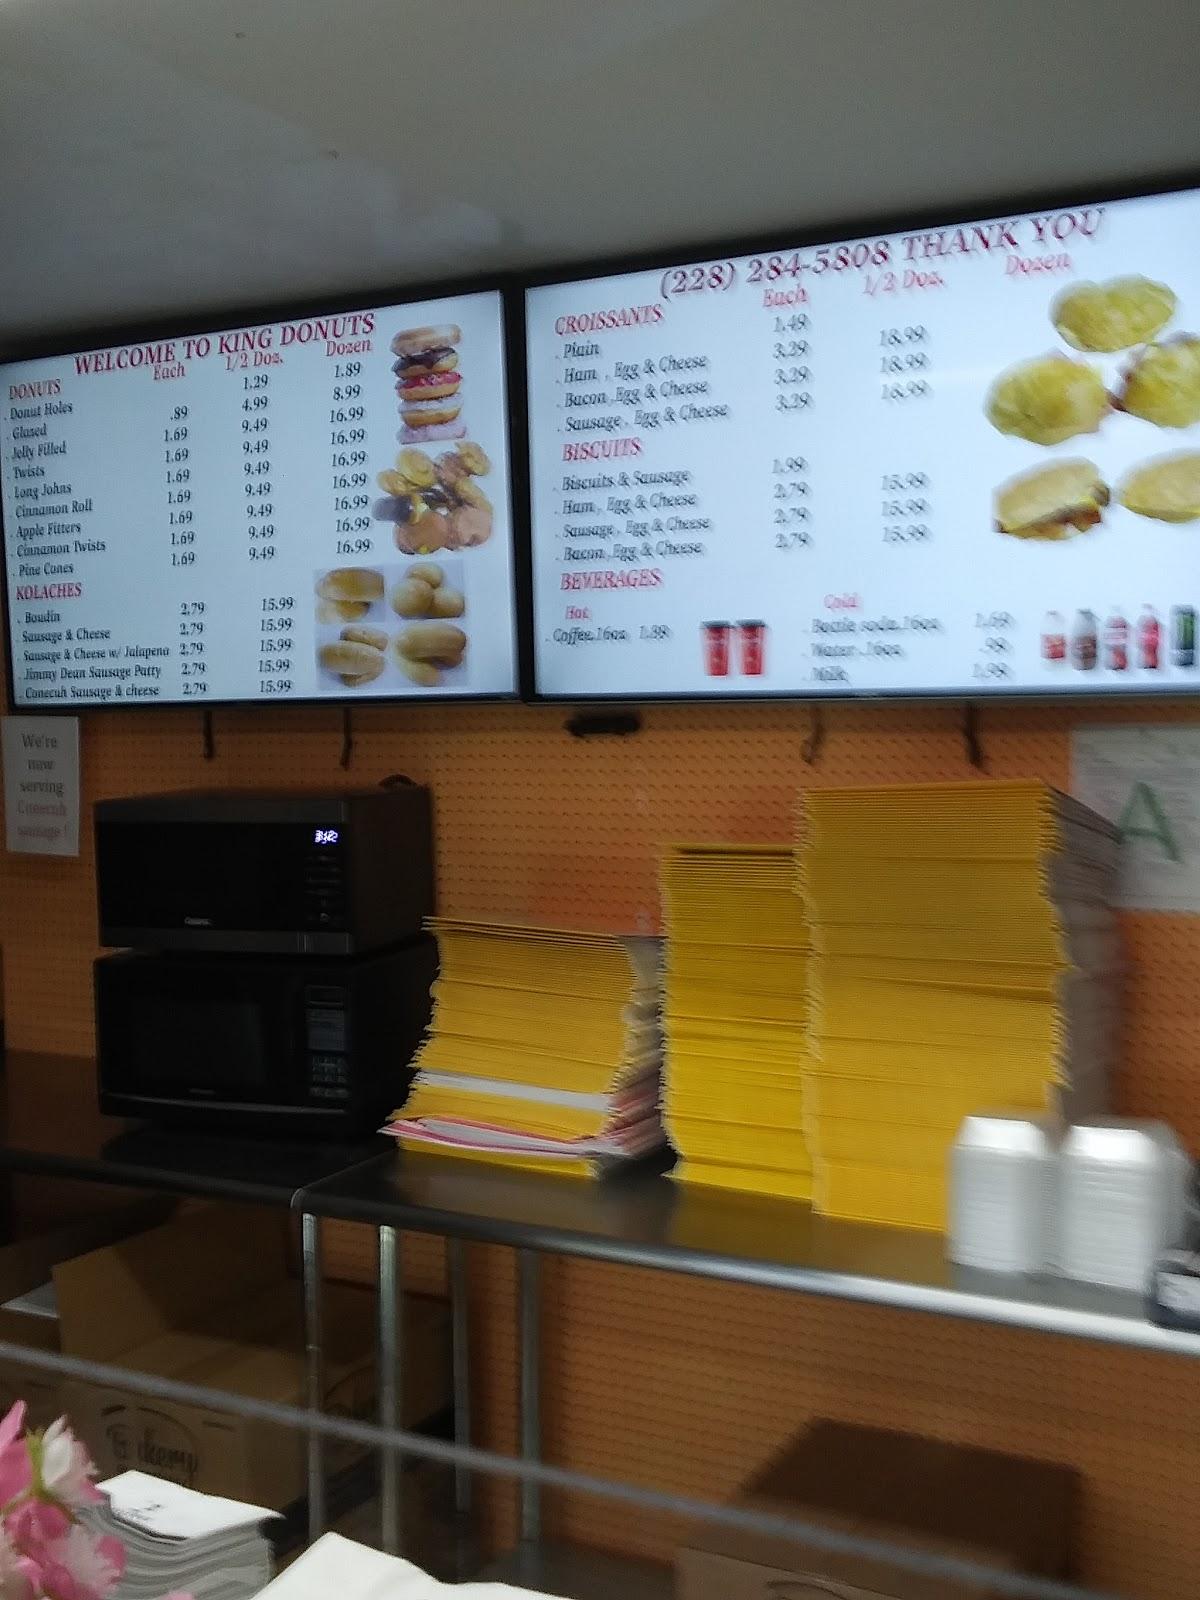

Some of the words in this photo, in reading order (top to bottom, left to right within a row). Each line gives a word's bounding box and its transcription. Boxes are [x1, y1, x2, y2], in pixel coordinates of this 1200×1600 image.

[659, 262, 736, 302] (228)
[745, 239, 891, 285] 284-5808
[902, 221, 1020, 262] THANK
[1028, 206, 1106, 244] YOU
[762, 284, 809, 309] Each
[863, 272, 896, 297] 1/2
[1005, 251, 1072, 276] Dozen
[554, 303, 664, 336] CROISSANTS
[74, 342, 175, 375] WELCOME
[182, 337, 210, 360] TO
[218, 328, 272, 354] KING
[280, 313, 374, 346] DONUTS
[563, 340, 601, 359] Plain
[773, 313, 809, 333] 1.49
[153, 362, 186, 381] Each
[225, 354, 248, 372] 1/2
[253, 351, 283, 367] Doz.
[326, 339, 371, 357] Dozen
[613, 361, 640, 381] Egg
[643, 359, 655, 375] &
[658, 354, 708, 373] Cheese
[9, 379, 61, 400] DONUTS
[10, 403, 41, 420] Donut
[44, 400, 73, 416] Holes
[243, 374, 269, 390] 1.29
[334, 362, 361, 378] 1.89
[644, 384, 656, 399] &
[660, 379, 709, 398] Cheese
[12, 424, 47, 440] Glazed
[170, 406, 188, 421] .89
[241, 396, 268, 411] 4.99
[333, 384, 361, 401] 8.99
[634, 408, 660, 429] Egg
[663, 406, 676, 422] &
[679, 403, 729, 421] Cheese
[12, 445, 34, 461] Jelly
[38, 441, 67, 456] Filled
[164, 427, 188, 442] 1.69
[241, 417, 268, 433] 9.49
[329, 406, 365, 423] 16.99
[13, 465, 45, 479] Twists
[165, 448, 189, 463] 1.69
[242, 439, 269, 455] 9.49
[330, 429, 365, 445] 16.99
[562, 437, 642, 462] BISCUITS
[14, 486, 38, 499] Long
[41, 482, 72, 496] Johns
[166, 469, 190, 484] 1.69
[243, 460, 270, 476] 9.49
[331, 450, 366, 467] 16.99
[561, 472, 615, 492] Biscuits
[618, 472, 630, 487] &
[633, 469, 692, 488] Sausage
[15, 502, 69, 518] Cinnamon
[72, 499, 93, 513] Roll
[167, 490, 191, 504] 1.69
[244, 482, 271, 497] 9.49
[332, 473, 367, 489] 16.99
[607, 496, 632, 514] Egg
[635, 494, 647, 510] &
[650, 492, 697, 508] Cheese
[773, 481, 810, 499] 2.79
[16, 525, 44, 541] Apple
[168, 511, 193, 525] 1.69
[246, 503, 273, 519] 9.49
[334, 495, 369, 511] 16.99
[626, 519, 650, 538] Egg
[652, 517, 664, 532] &
[666, 516, 711, 531] Cheese
[773, 507, 810, 524] 2.79
[16, 543, 70, 557] Cinnamon
[73, 540, 106, 553] Twists
[170, 531, 195, 545] 1.69
[248, 524, 275, 540] 9.49
[335, 517, 370, 532] 16.99
[641, 541, 653, 556] &
[656, 539, 705, 556] Cheese
[775, 532, 811, 549] 2.79
[19, 564, 40, 577] Pine
[44, 562, 74, 575] Cones
[171, 552, 195, 566] 1.69
[248, 546, 275, 561] 9.49
[336, 539, 371, 554] 16.99
[16, 582, 82, 600] KOLACHES
[560, 568, 664, 590] BEVERAGES
[25, 610, 61, 624] Boudin
[181, 602, 205, 615] 2.79
[261, 597, 294, 611] 15.99
[565, 605, 590, 620] Hot
[22, 630, 62, 644] Sausage
[65, 630, 73, 640] &
[76, 628, 111, 640] Cheese
[179, 622, 204, 636] 2.79
[260, 618, 292, 632] 15.99
[23, 650, 61, 664] Sausage
[63, 650, 71, 660] &
[73, 648, 106, 660] Cheese
[179, 643, 203, 655] 2.79
[260, 638, 292, 652] 15.99
[24, 670, 56, 683] Jimmy
[60, 668, 86, 680] Dean
[89, 666, 131, 680] Sausage
[134, 664, 162, 678] Patty
[181, 663, 206, 675] 2.79
[258, 659, 291, 673] 15.99
[70, 686, 112, 700] Sausage
[115, 685, 122, 696] &
[126, 684, 160, 696] cheese
[182, 683, 207, 695] 2.79
[260, 679, 292, 693] 15.99
[21, 733, 57, 748] We're
[28, 760, 54, 770] now
[19, 782, 65, 798] serving
[1118, 780, 1185, 863] A
